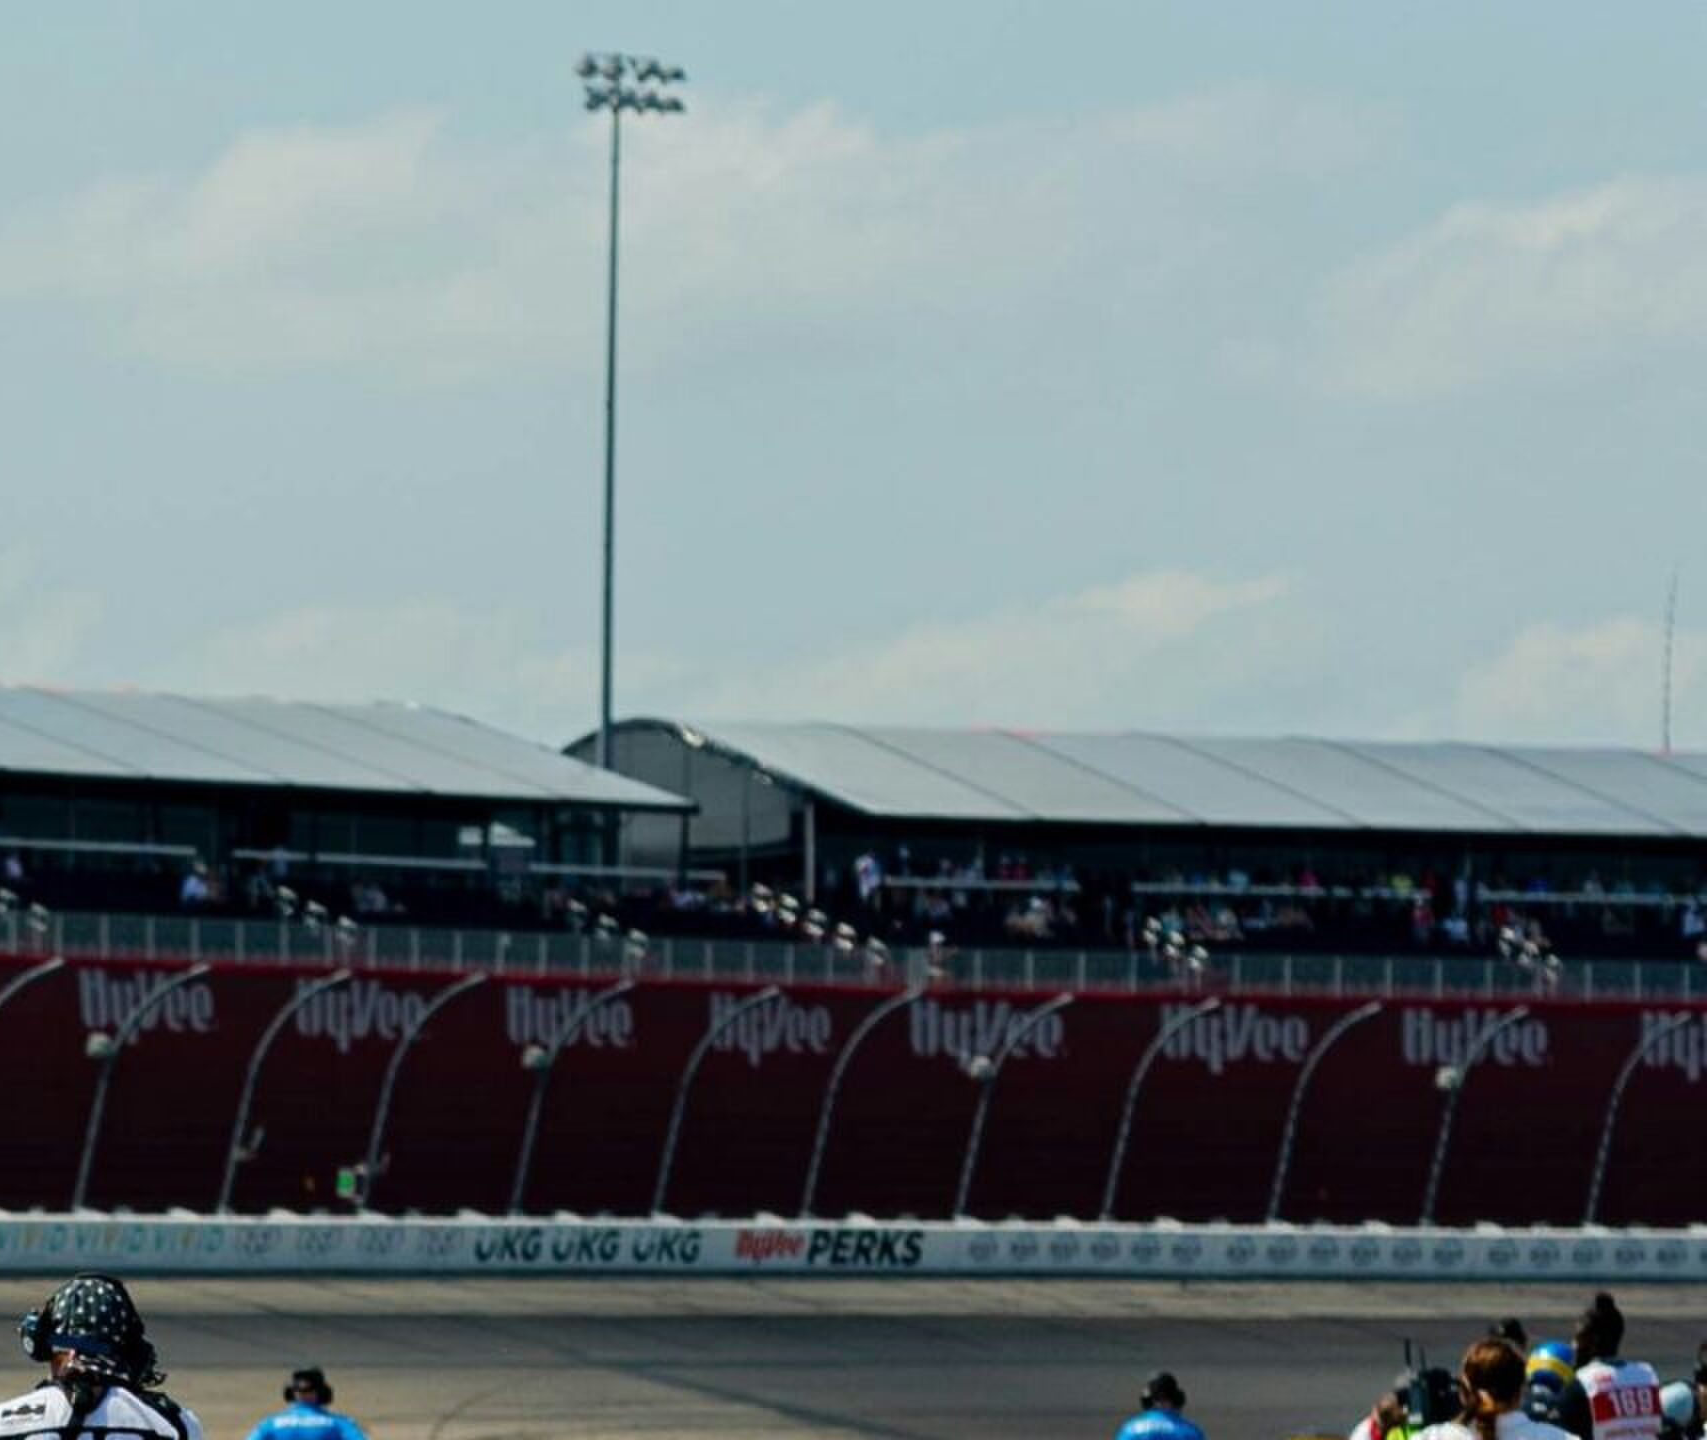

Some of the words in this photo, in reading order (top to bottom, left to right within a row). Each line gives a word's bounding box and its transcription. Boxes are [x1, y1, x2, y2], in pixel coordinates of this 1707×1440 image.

[475, 1229, 543, 1262] UKG
[553, 1230, 623, 1263] UKG
[633, 1231, 702, 1263] UKG
[808, 1229, 924, 1266] PERKS
